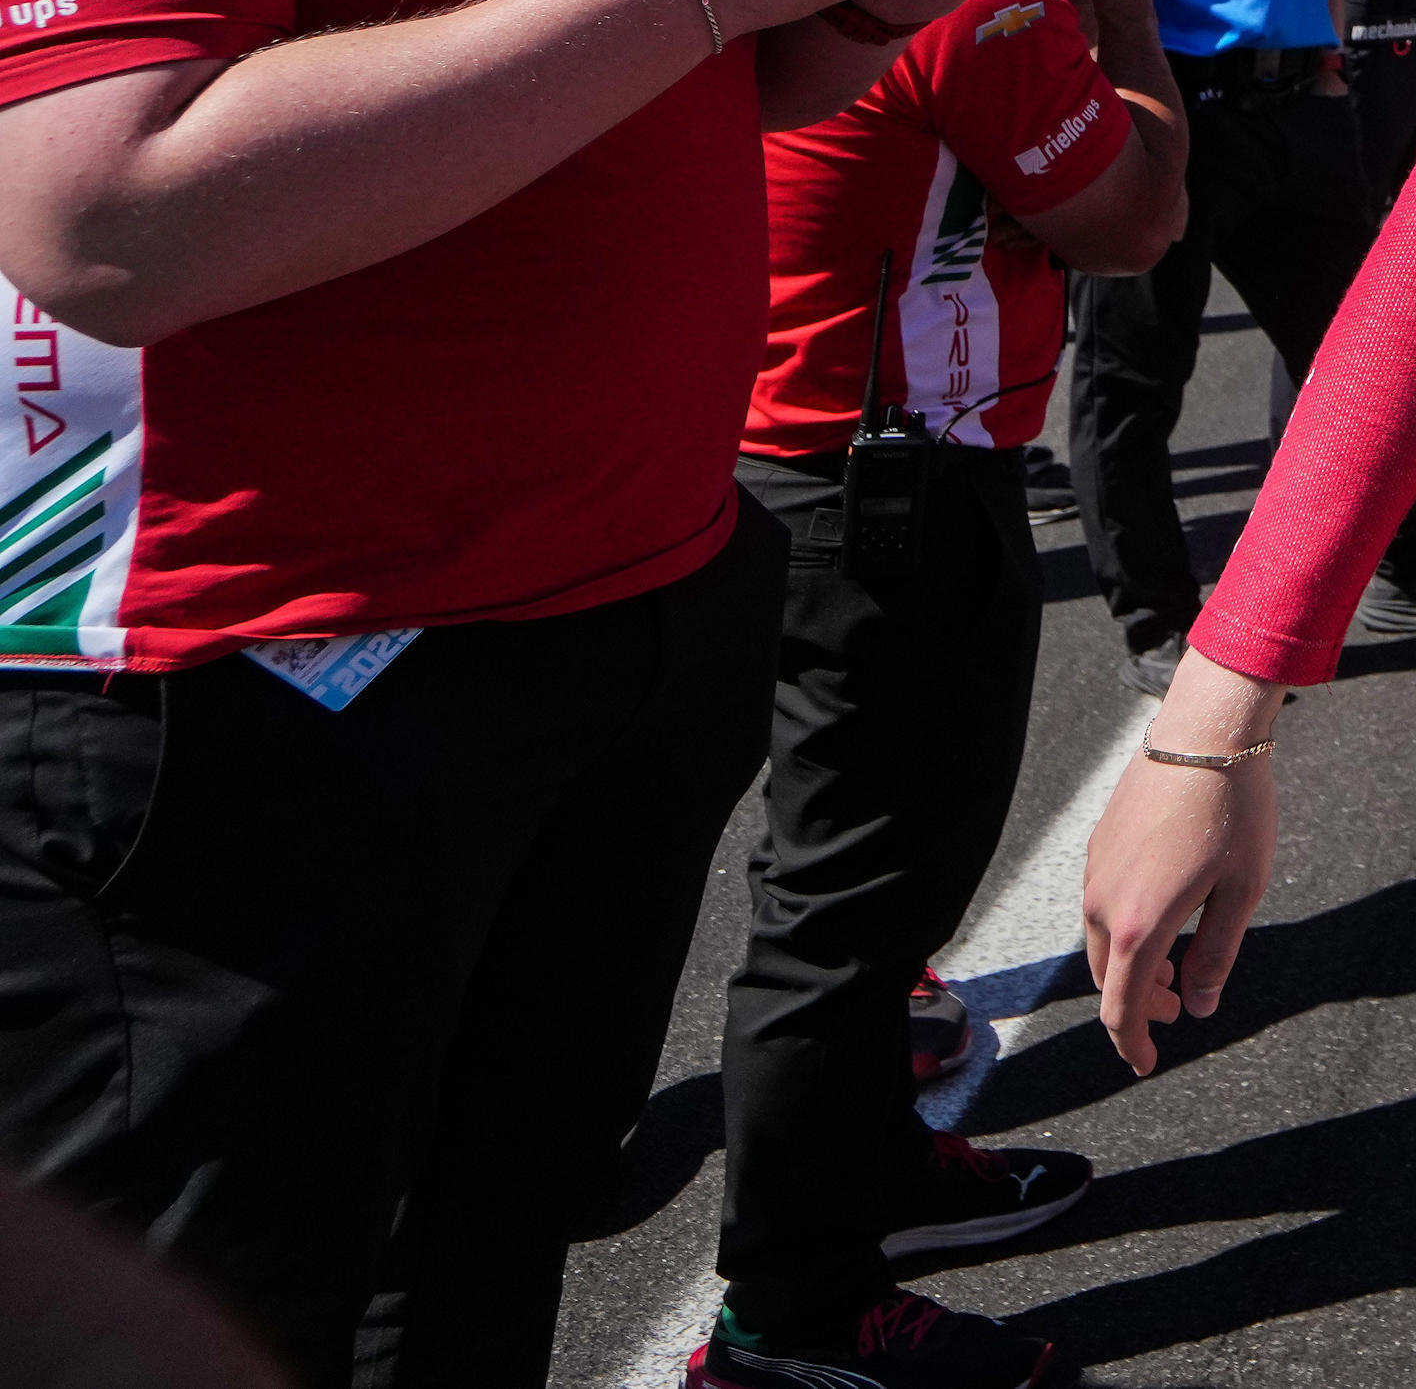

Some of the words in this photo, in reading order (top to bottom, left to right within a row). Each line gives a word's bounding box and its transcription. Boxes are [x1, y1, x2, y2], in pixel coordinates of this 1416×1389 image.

[1043, 116, 1087, 161] riello
[1081, 98, 1100, 123] ups
[331, 628, 410, 696] 202
